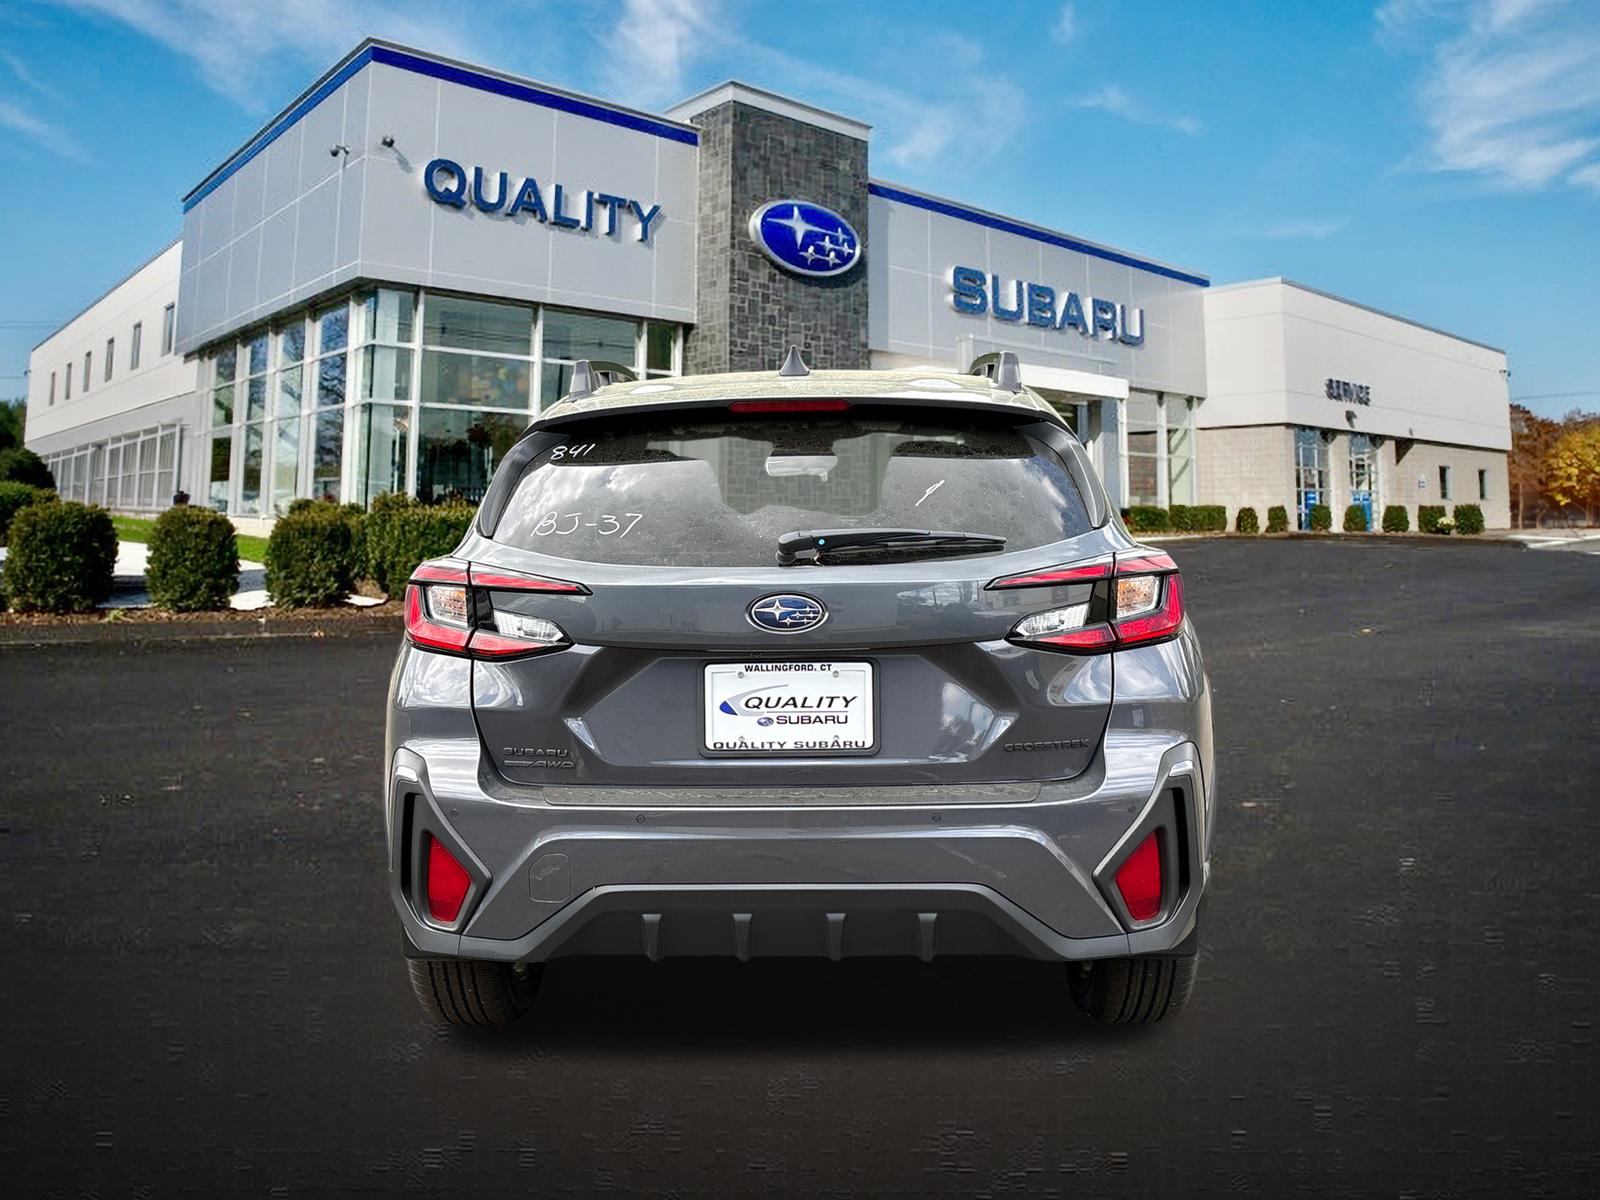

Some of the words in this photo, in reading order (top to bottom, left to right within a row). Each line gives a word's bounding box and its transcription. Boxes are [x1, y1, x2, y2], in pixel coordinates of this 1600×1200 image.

[424, 158, 661, 243] QUALITY
[950, 265, 1145, 347] SUBARU
[550, 443, 596, 461] 841
[820, 664, 832, 672] CT
[744, 696, 857, 709] QUALITY
[776, 715, 848, 725] SUBARU
[794, 741, 865, 749] SUBARU
[1004, 739, 1090, 752] CROSSTREK
[503, 747, 568, 757] SUBARU
[530, 760, 575, 768] AWD
